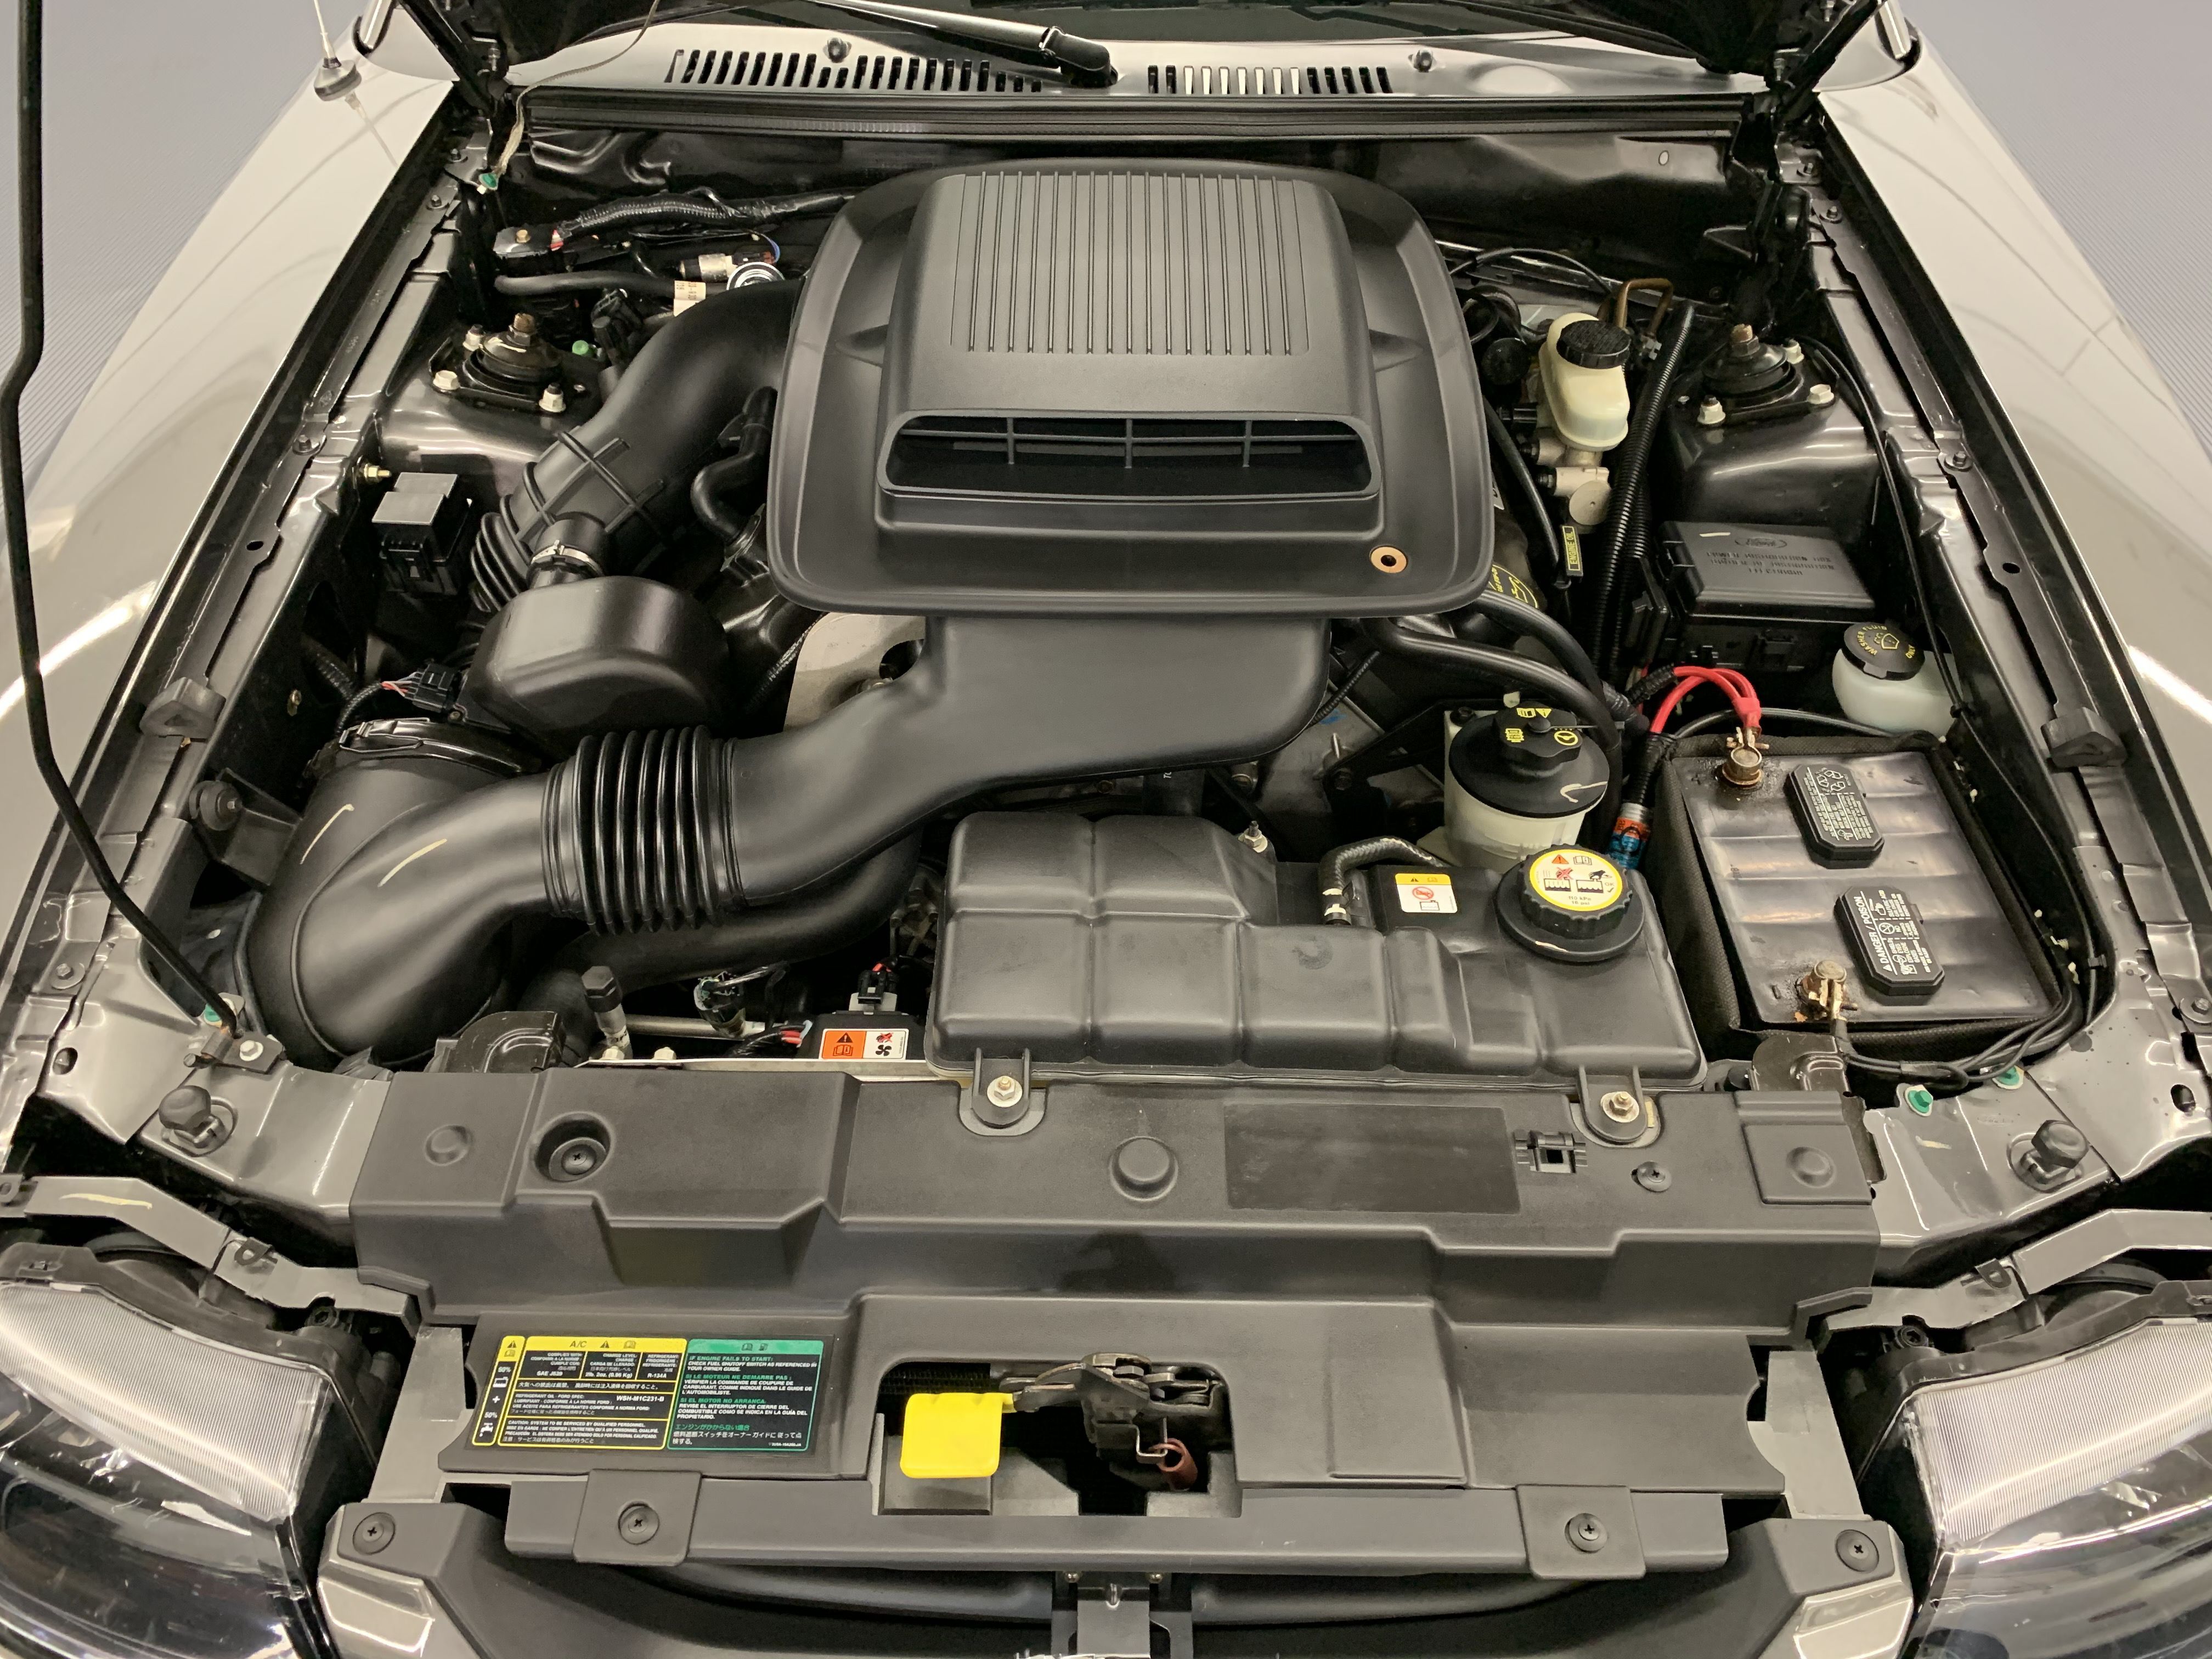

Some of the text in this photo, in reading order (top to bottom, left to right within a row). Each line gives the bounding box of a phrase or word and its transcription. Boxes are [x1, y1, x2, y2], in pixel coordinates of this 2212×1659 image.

[1566, 532, 1578, 564] ENGINE OIL
[1857, 631, 1878, 656] WASHER
[1905, 644, 1916, 658] ONLY
[1854, 896, 1873, 924] POISON
[1869, 932, 1889, 964] DANGER
[1887, 940, 1898, 954] SHIELD
[1895, 943, 1904, 954] EYES
